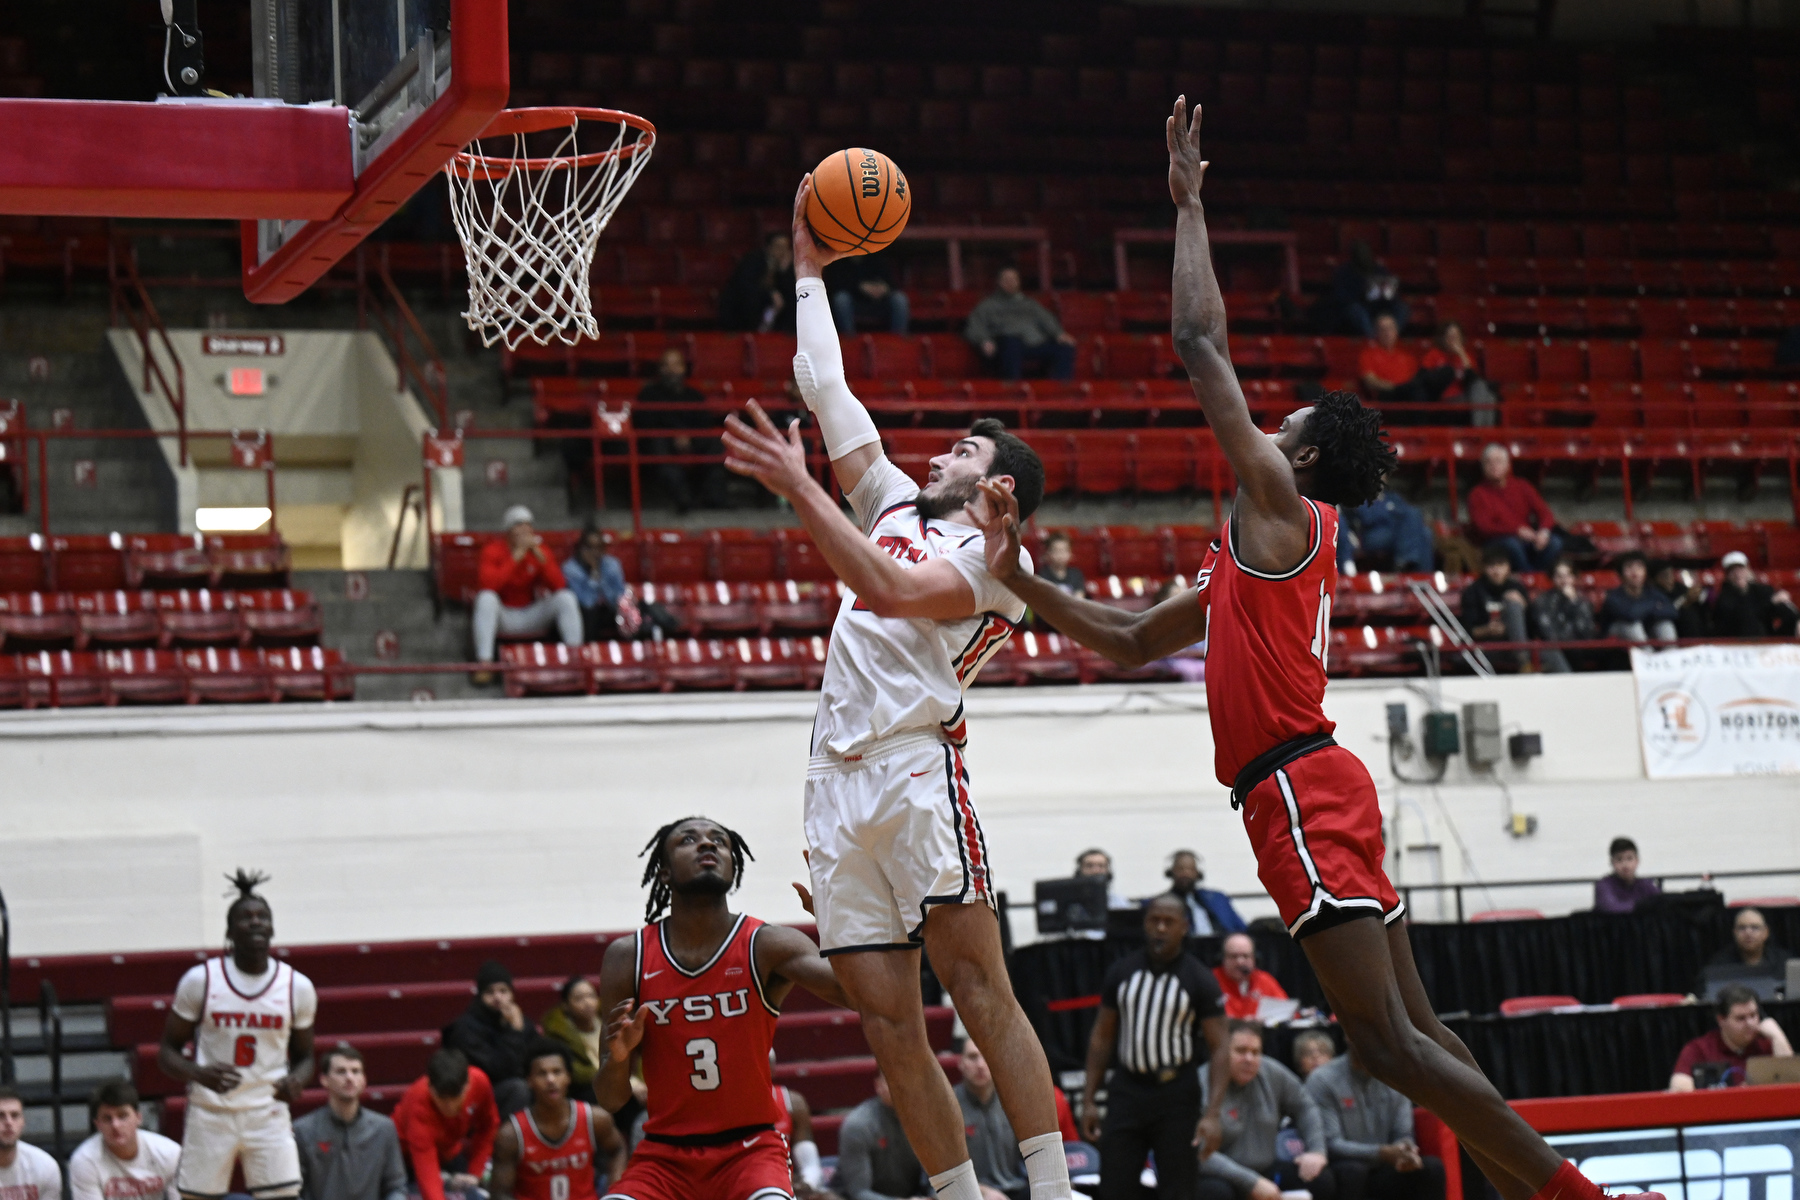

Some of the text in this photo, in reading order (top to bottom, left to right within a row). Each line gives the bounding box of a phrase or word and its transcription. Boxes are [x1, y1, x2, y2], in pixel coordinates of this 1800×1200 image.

[876, 535, 928, 564] TITA
[211, 1012, 283, 1029] TITANS
[643, 988, 749, 1025] YSU
[234, 1034, 256, 1067] 6
[685, 1037, 721, 1091] 3
[1566, 1143, 1794, 1200] SPN
